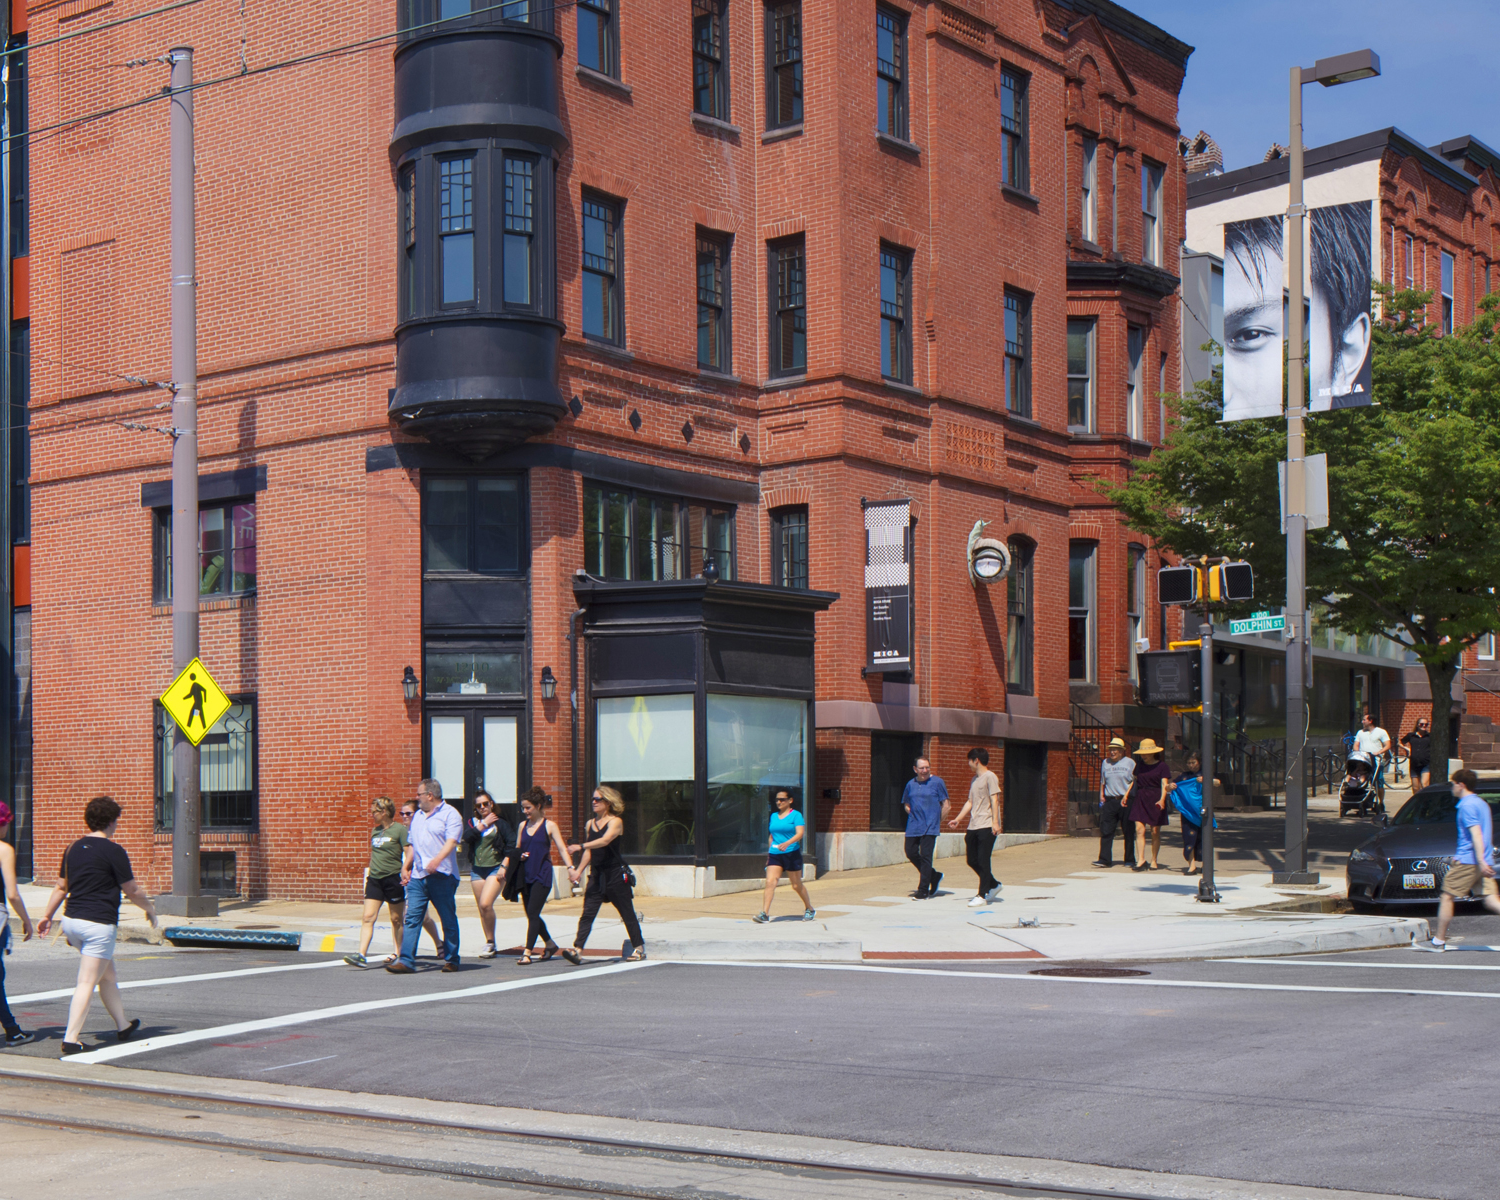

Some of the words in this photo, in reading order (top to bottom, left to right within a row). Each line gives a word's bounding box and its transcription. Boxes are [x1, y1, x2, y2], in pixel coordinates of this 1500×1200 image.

[1234, 620, 1272, 632] DOLPHIN
[1149, 692, 1167, 700] TRAIN
[1167, 692, 1190, 700] COMING
